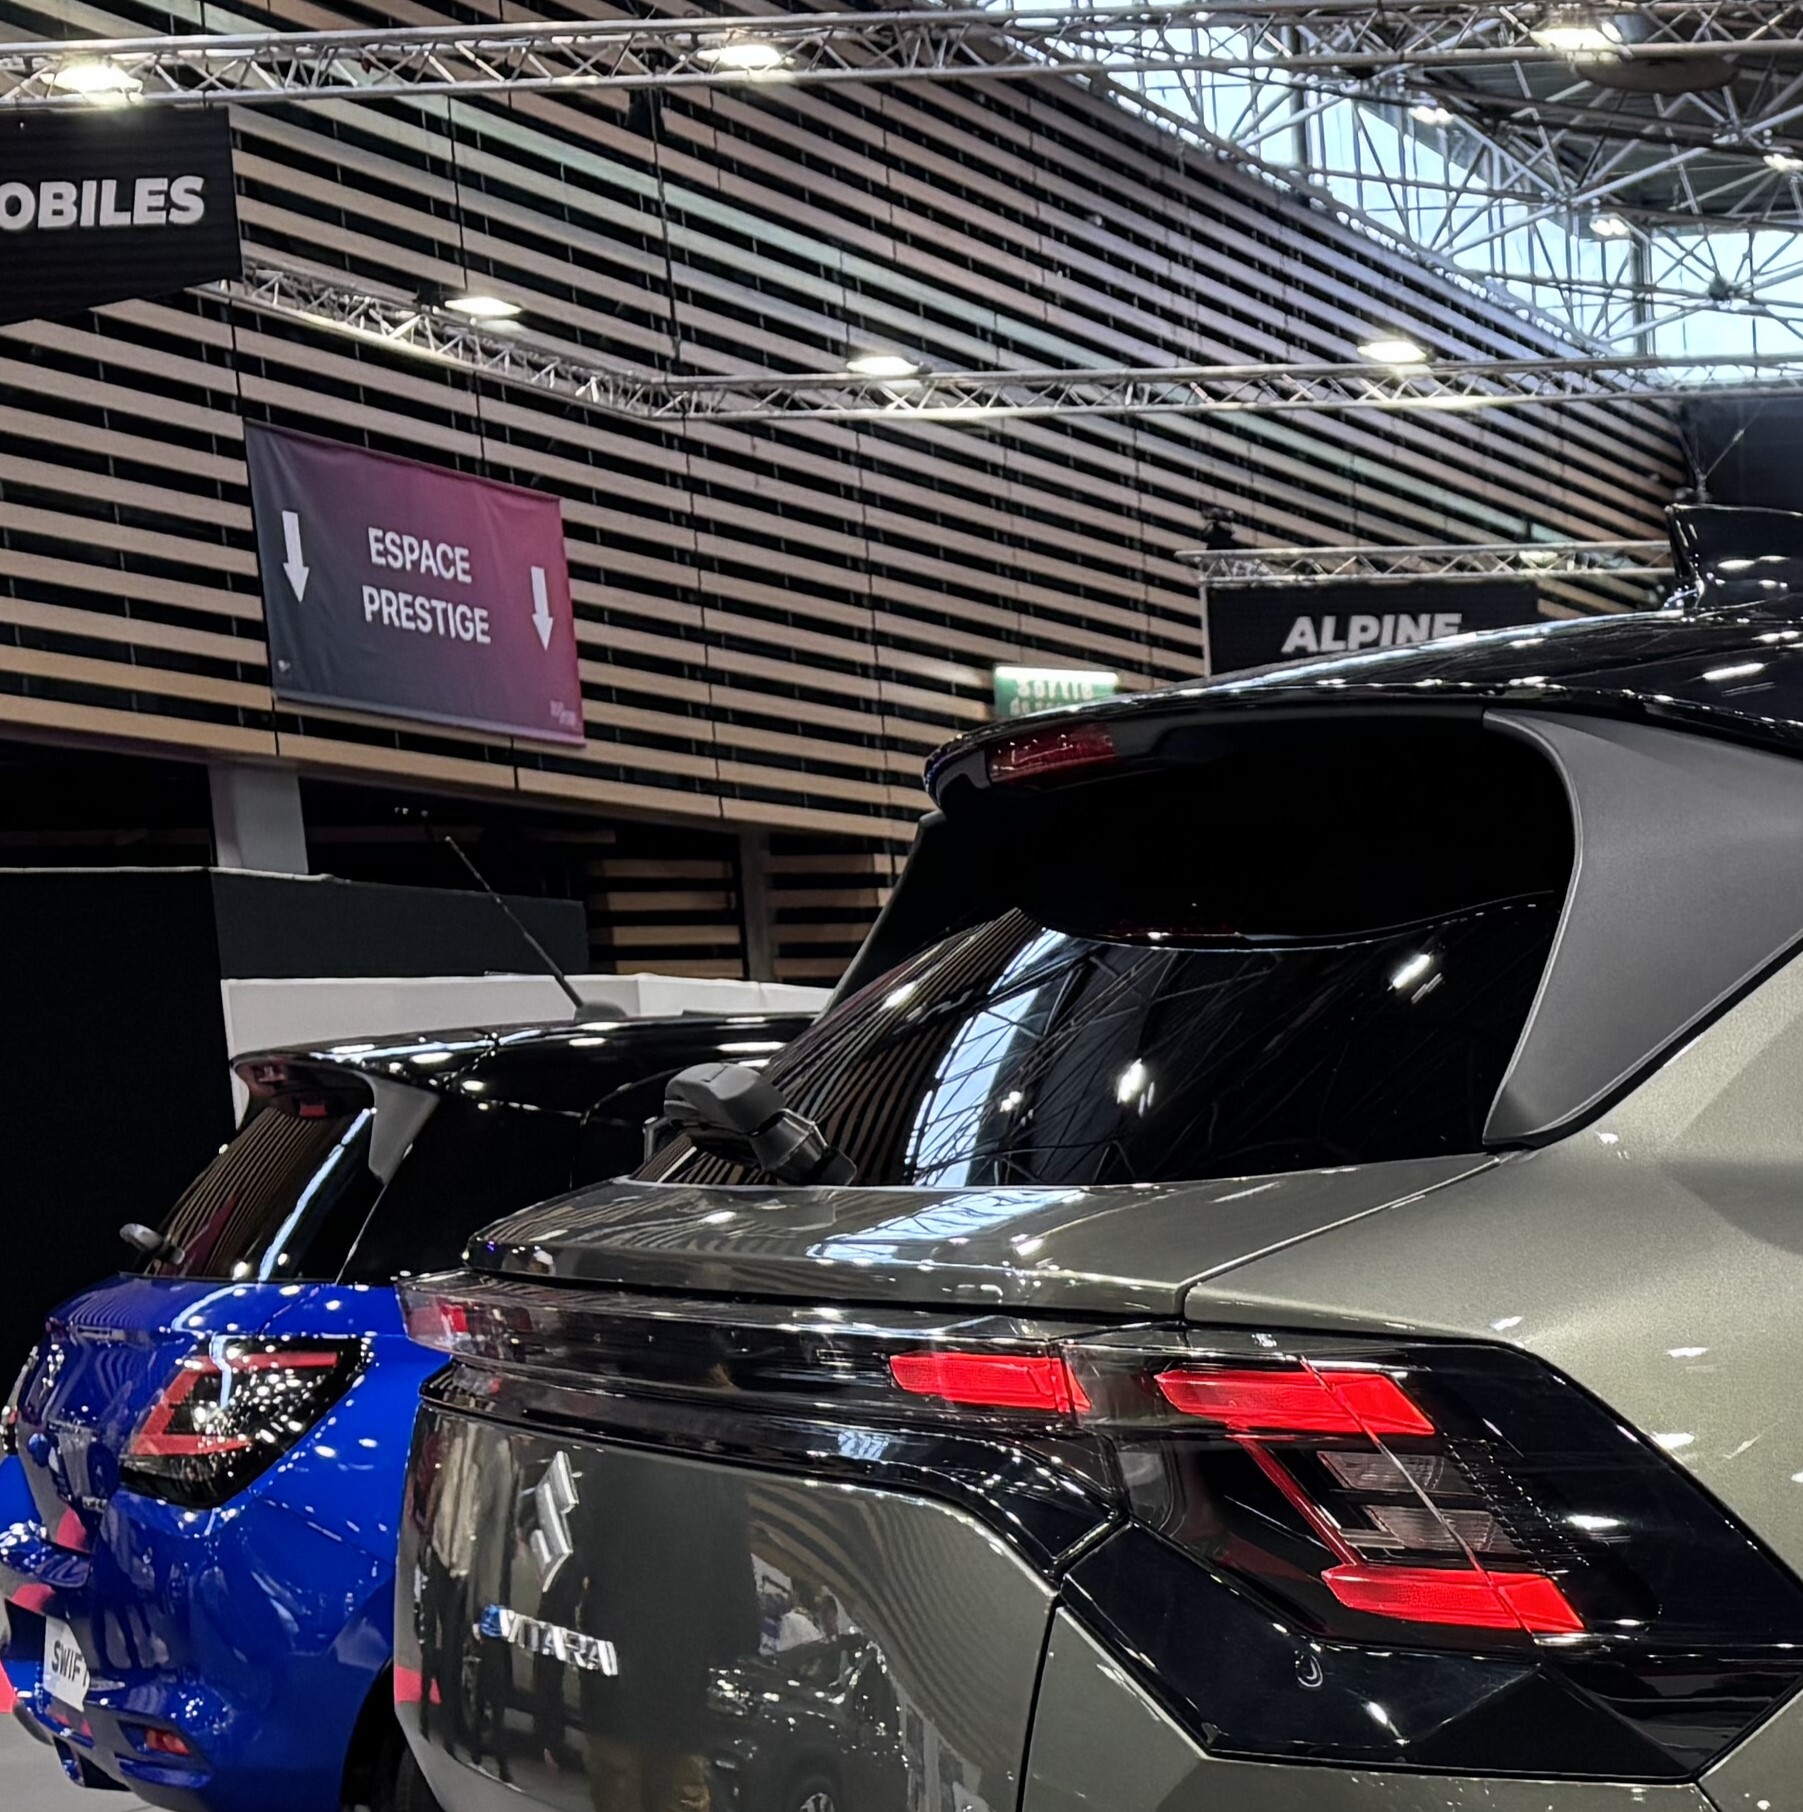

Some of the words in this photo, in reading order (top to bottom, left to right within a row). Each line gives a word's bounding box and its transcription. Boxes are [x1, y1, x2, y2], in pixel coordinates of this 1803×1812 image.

[367, 526, 473, 584] ESPACE
[361, 584, 492, 644] PRESTIGE
[1281, 613, 1462, 653] ALPINE
